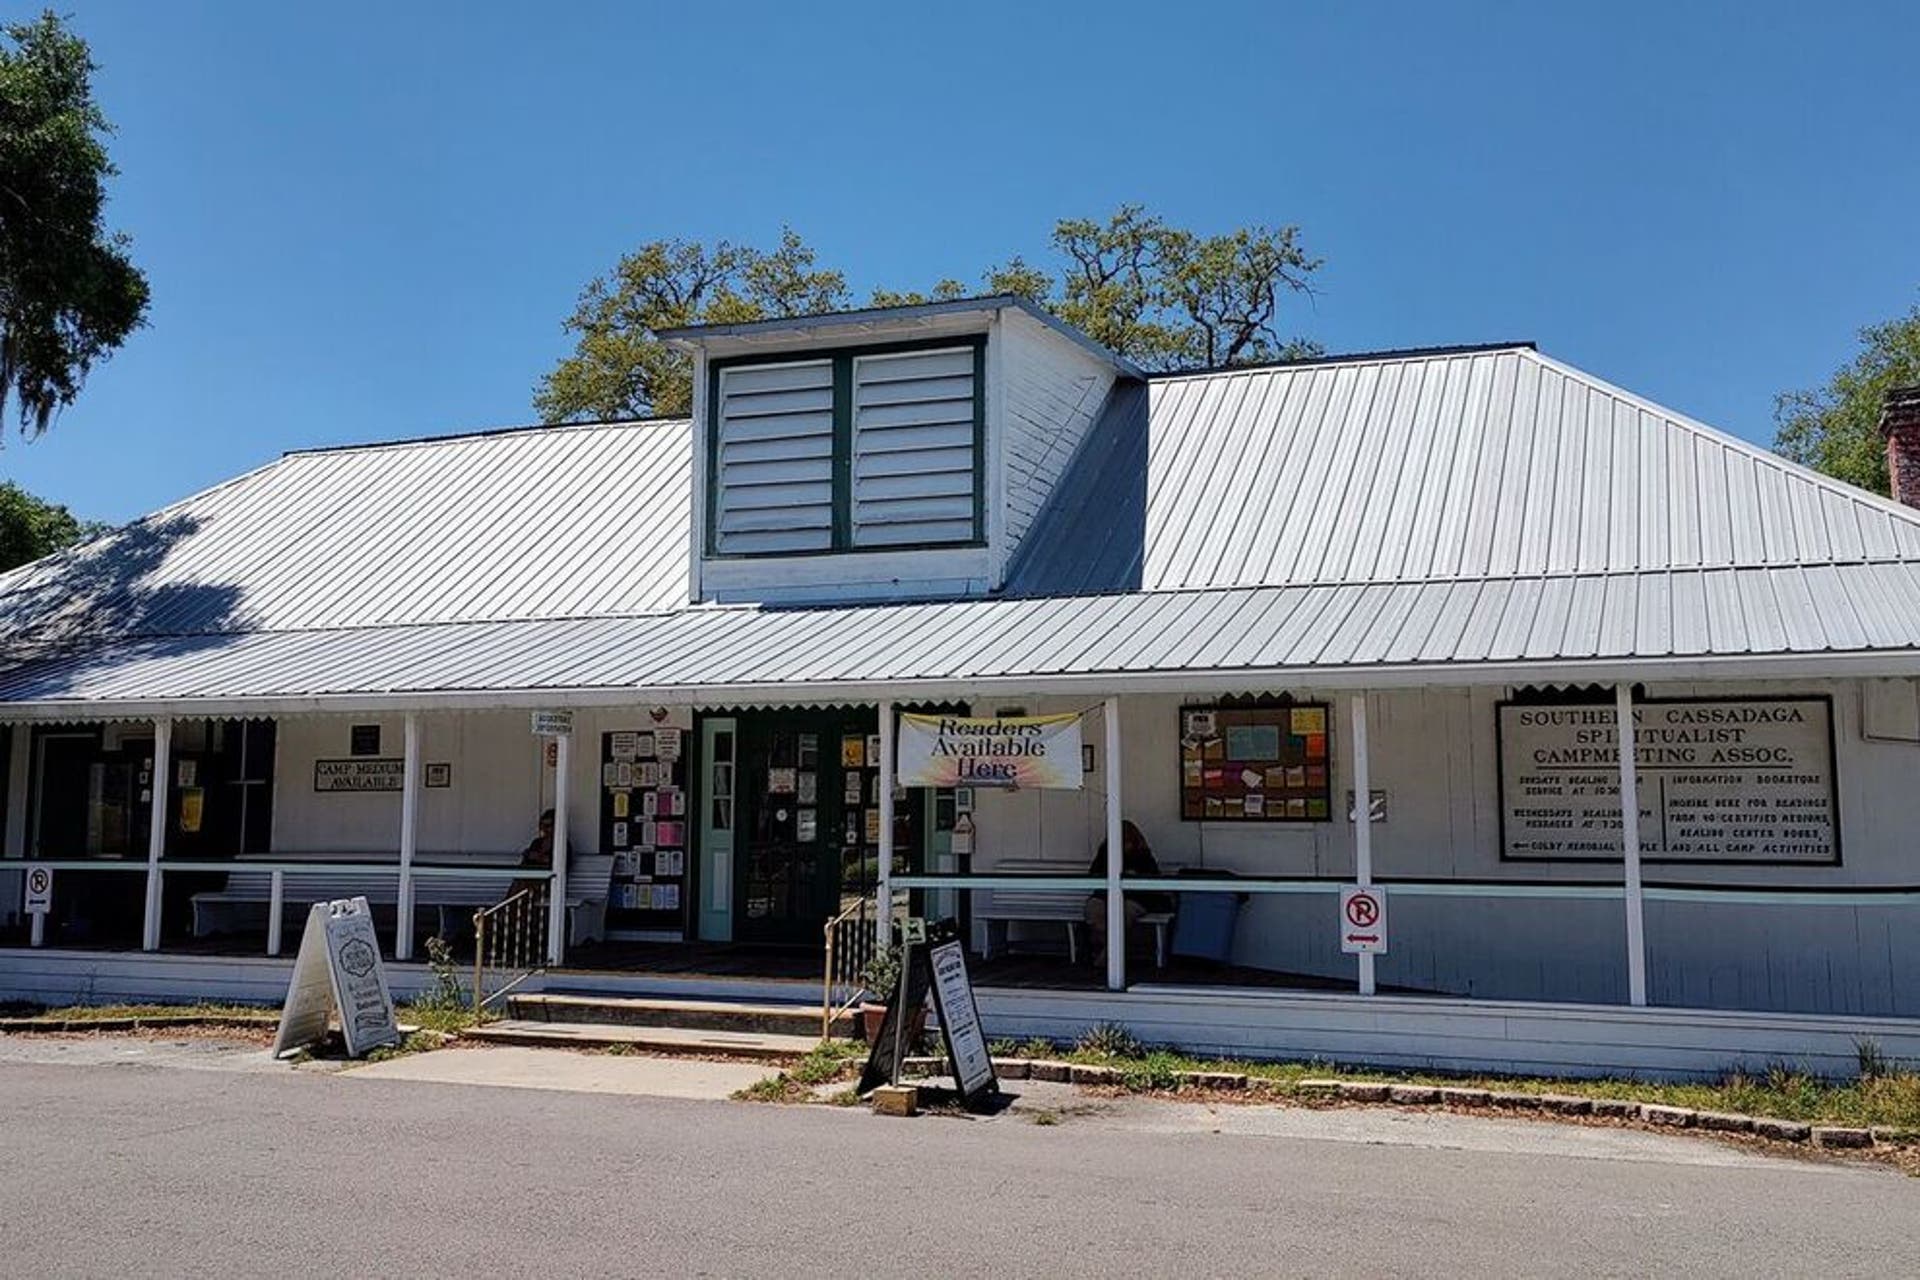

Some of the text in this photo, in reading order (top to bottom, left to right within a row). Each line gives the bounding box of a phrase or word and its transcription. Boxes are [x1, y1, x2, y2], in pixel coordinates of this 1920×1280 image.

[1520, 708, 1804, 726] SOUTHEN CASSADAGA
[938, 719, 1043, 736] Readers
[1576, 728, 1746, 744] SPIITUALIST
[931, 737, 1046, 757] Available
[1711, 747, 1794, 763] ASSOC.
[957, 758, 1017, 778] Here
